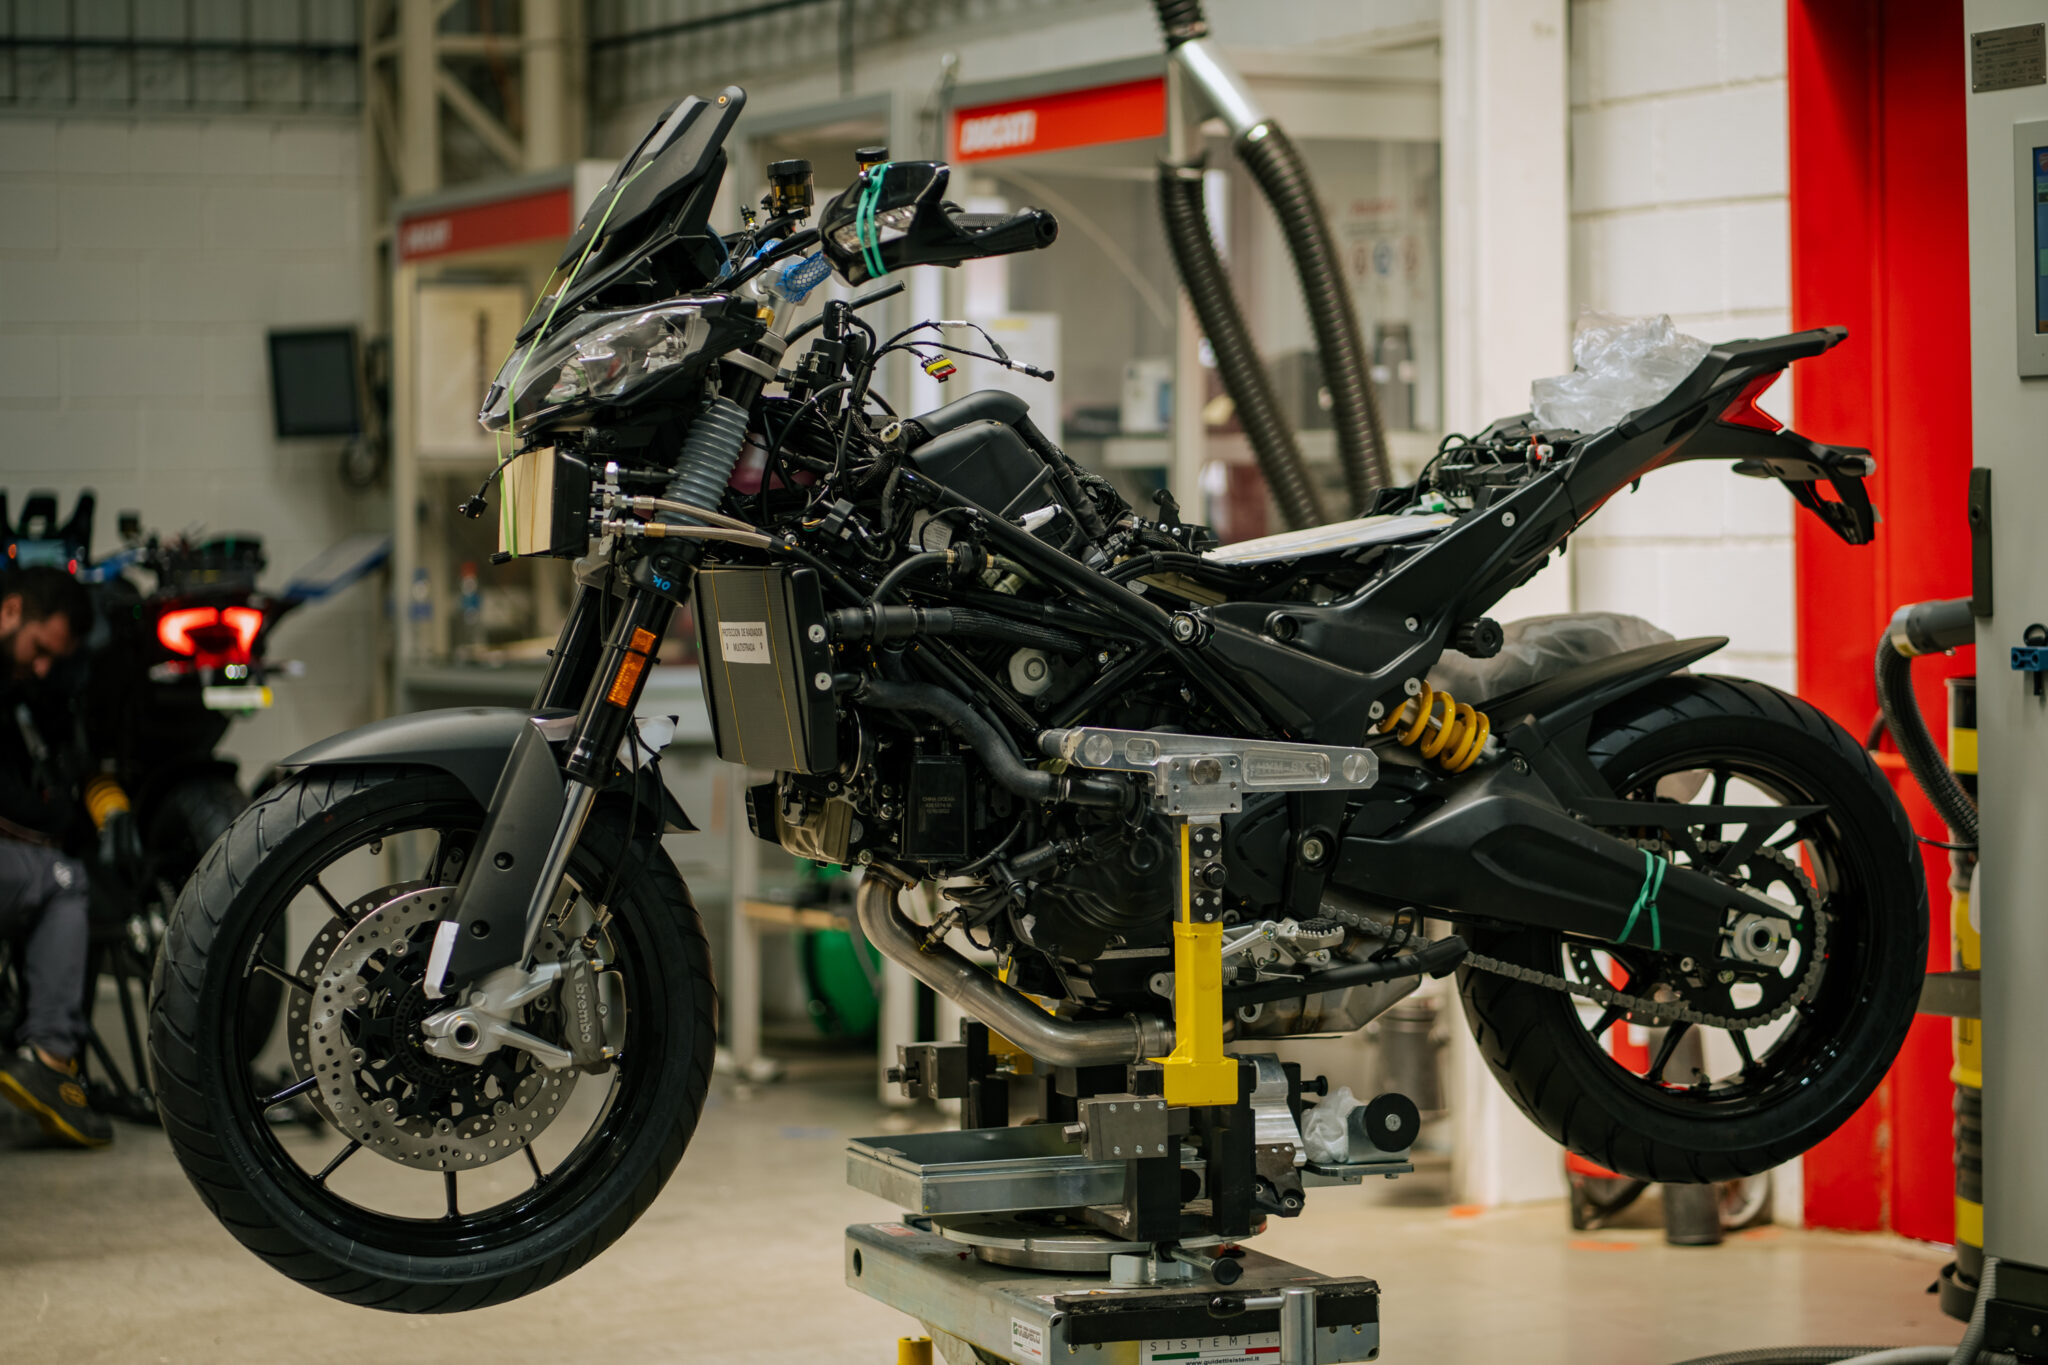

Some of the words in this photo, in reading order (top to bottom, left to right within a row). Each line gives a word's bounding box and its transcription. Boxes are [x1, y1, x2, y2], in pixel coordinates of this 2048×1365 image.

[653, 575, 671, 591] OK
[575, 983, 592, 1043] brembo
[1150, 1335, 1251, 1351] SISTEMI
[1185, 1356, 1259, 1365] www.guidettisistemi.it
